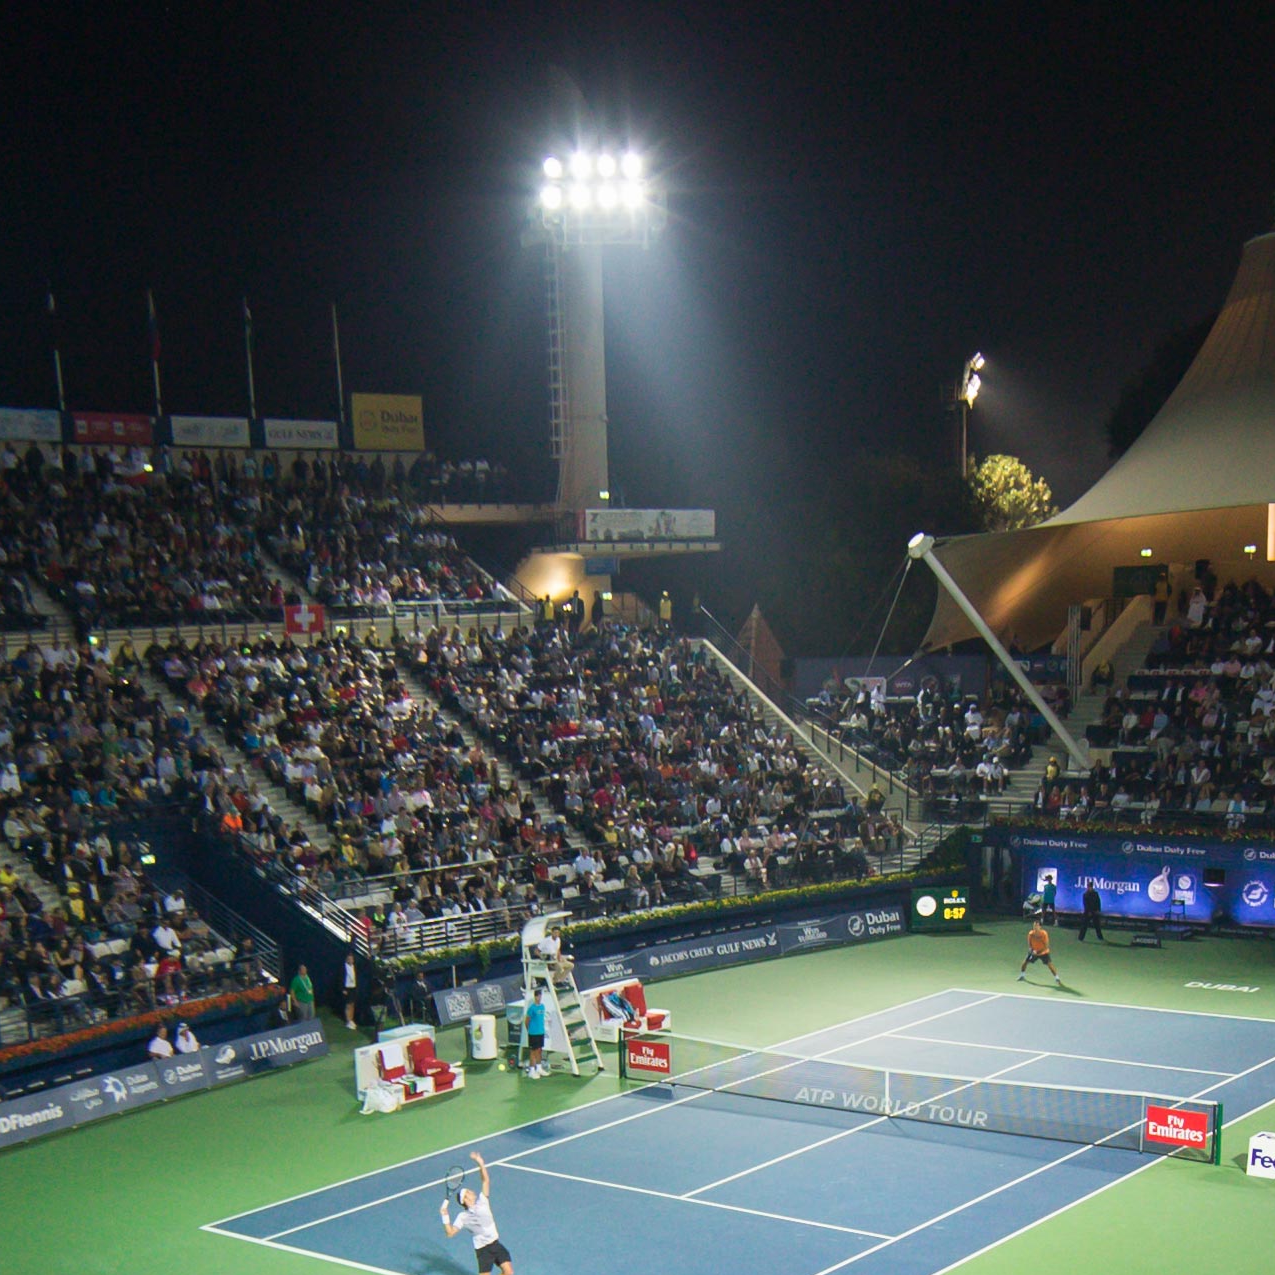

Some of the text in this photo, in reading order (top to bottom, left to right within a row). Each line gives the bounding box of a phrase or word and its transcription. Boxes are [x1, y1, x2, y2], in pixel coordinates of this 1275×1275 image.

[1023, 838, 1088, 849] Dubai Duty Free
[1136, 844, 1206, 855] Dubai Duty Free
[1074, 876, 1140, 893] J.PMorgan
[866, 911, 900, 926] Dubai
[868, 924, 902, 935] Duty Free
[716, 944, 741, 956] GULF
[742, 938, 767, 952] NEWS
[1184, 981, 1260, 993] DUBAI
[249, 1031, 323, 1061] J.P.Morgan
[642, 1046, 655, 1057] Fly
[630, 1054, 668, 1068] Emirates
[794, 1087, 988, 1127] ATP WORLD TOUR
[1167, 1115, 1185, 1128] Fly
[1149, 1122, 1203, 1142] Emirates
